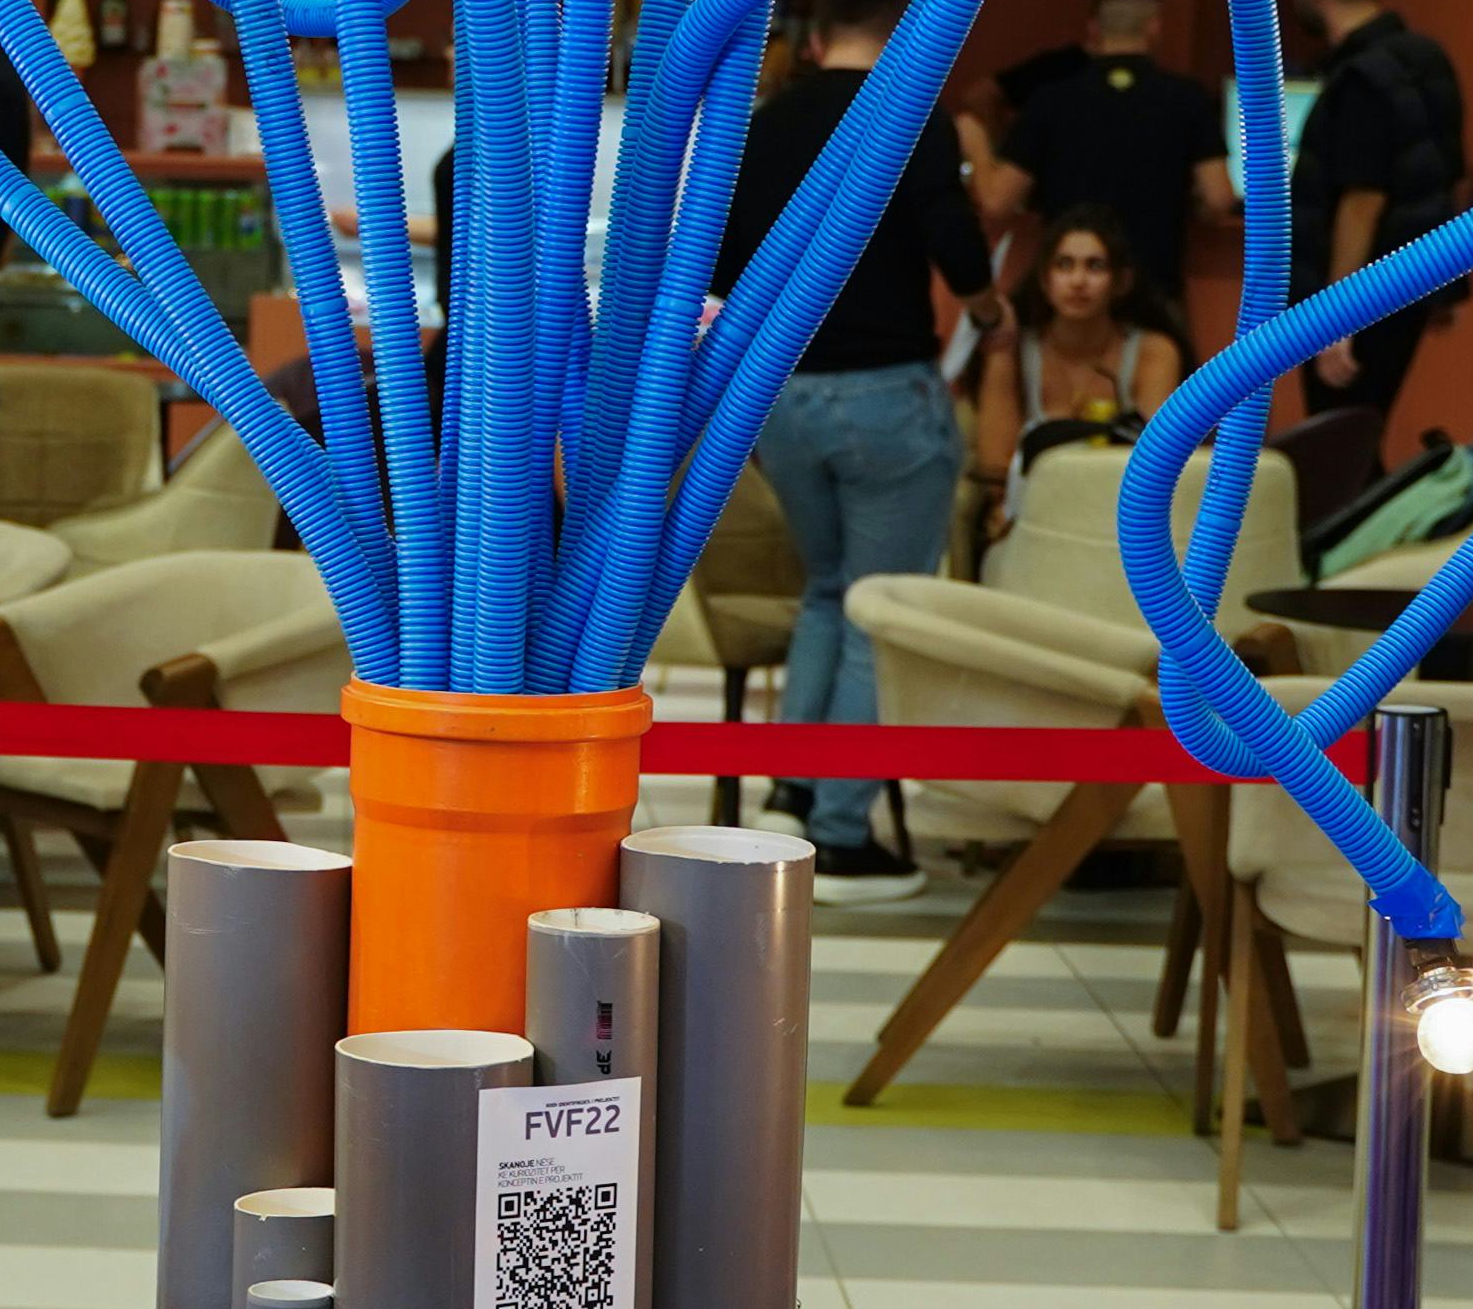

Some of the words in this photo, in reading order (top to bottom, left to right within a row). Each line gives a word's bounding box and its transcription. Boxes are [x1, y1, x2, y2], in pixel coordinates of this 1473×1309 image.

[525, 1104, 621, 1140] FVF22
[498, 1159, 534, 1170] SKANOJE
[545, 1172, 584, 1184] PROJEKTIT
